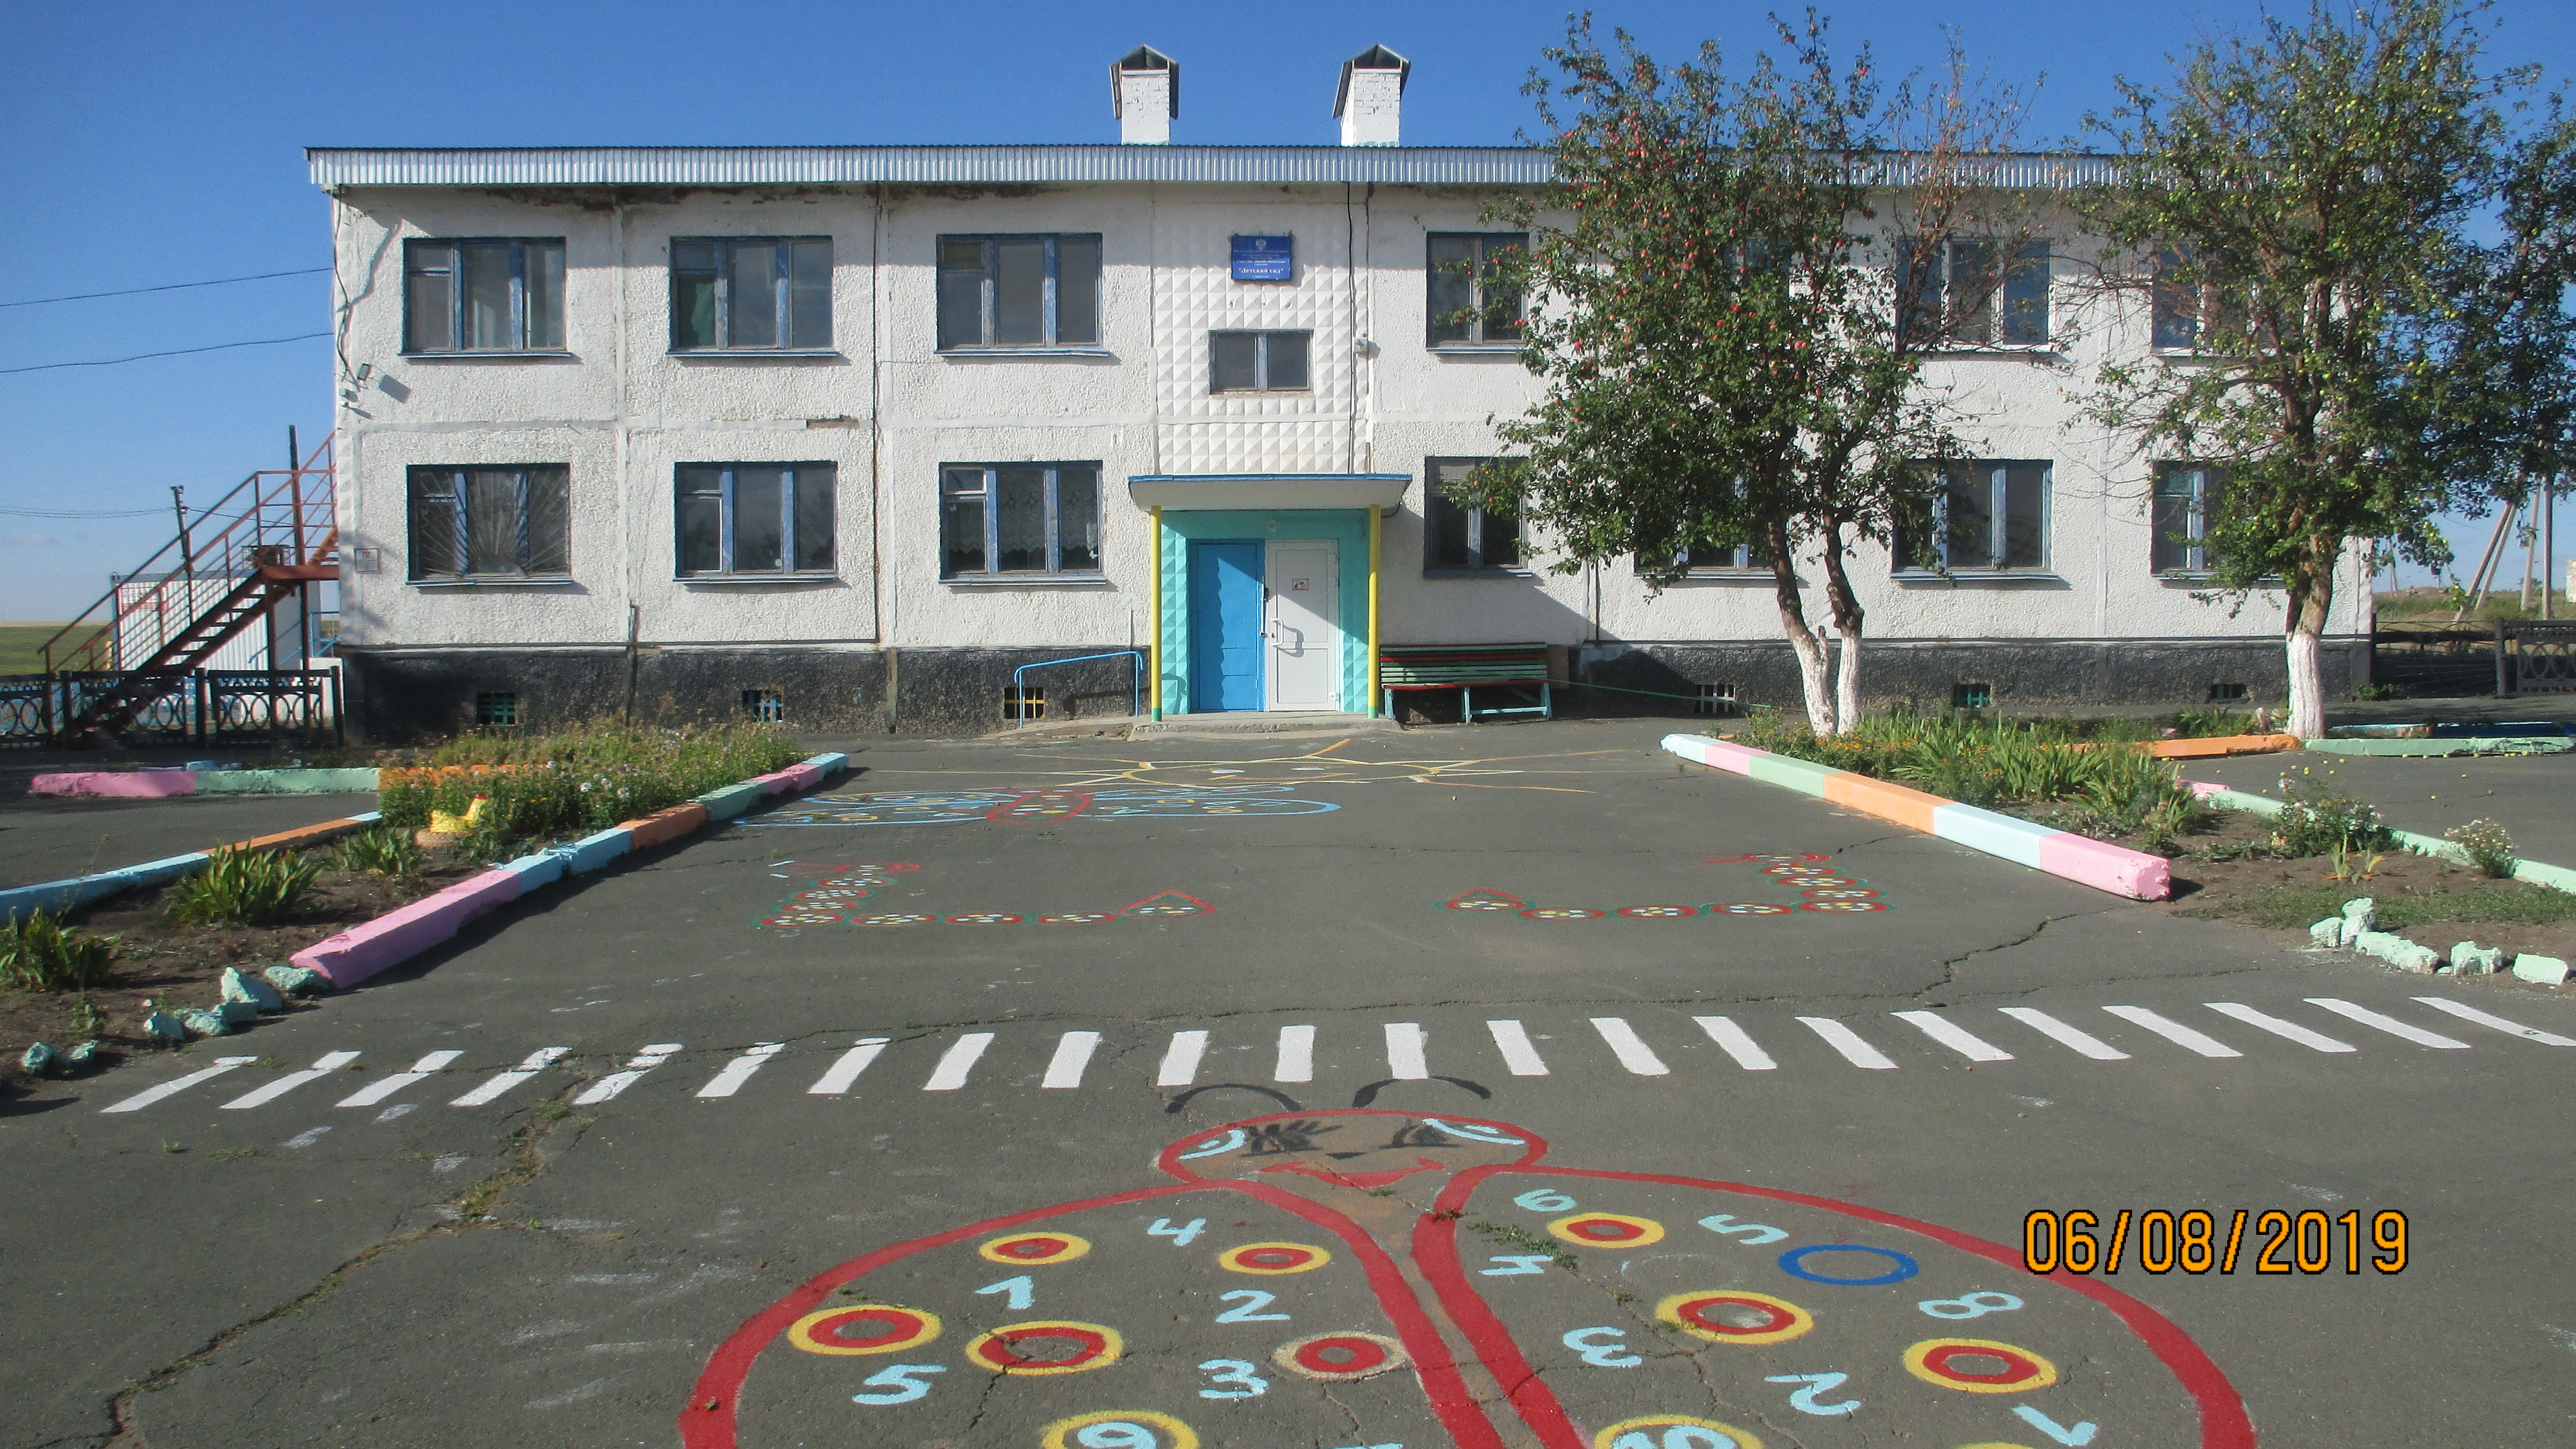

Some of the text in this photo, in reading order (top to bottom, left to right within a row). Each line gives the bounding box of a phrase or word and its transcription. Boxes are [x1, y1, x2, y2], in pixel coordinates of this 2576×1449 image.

[1147, 1217, 1207, 1246] 4
[1215, 1289, 1291, 1323] 2
[1917, 1290, 2023, 1319] 8
[851, 1363, 949, 1405] 5
[1197, 1358, 1270, 1400] 3
